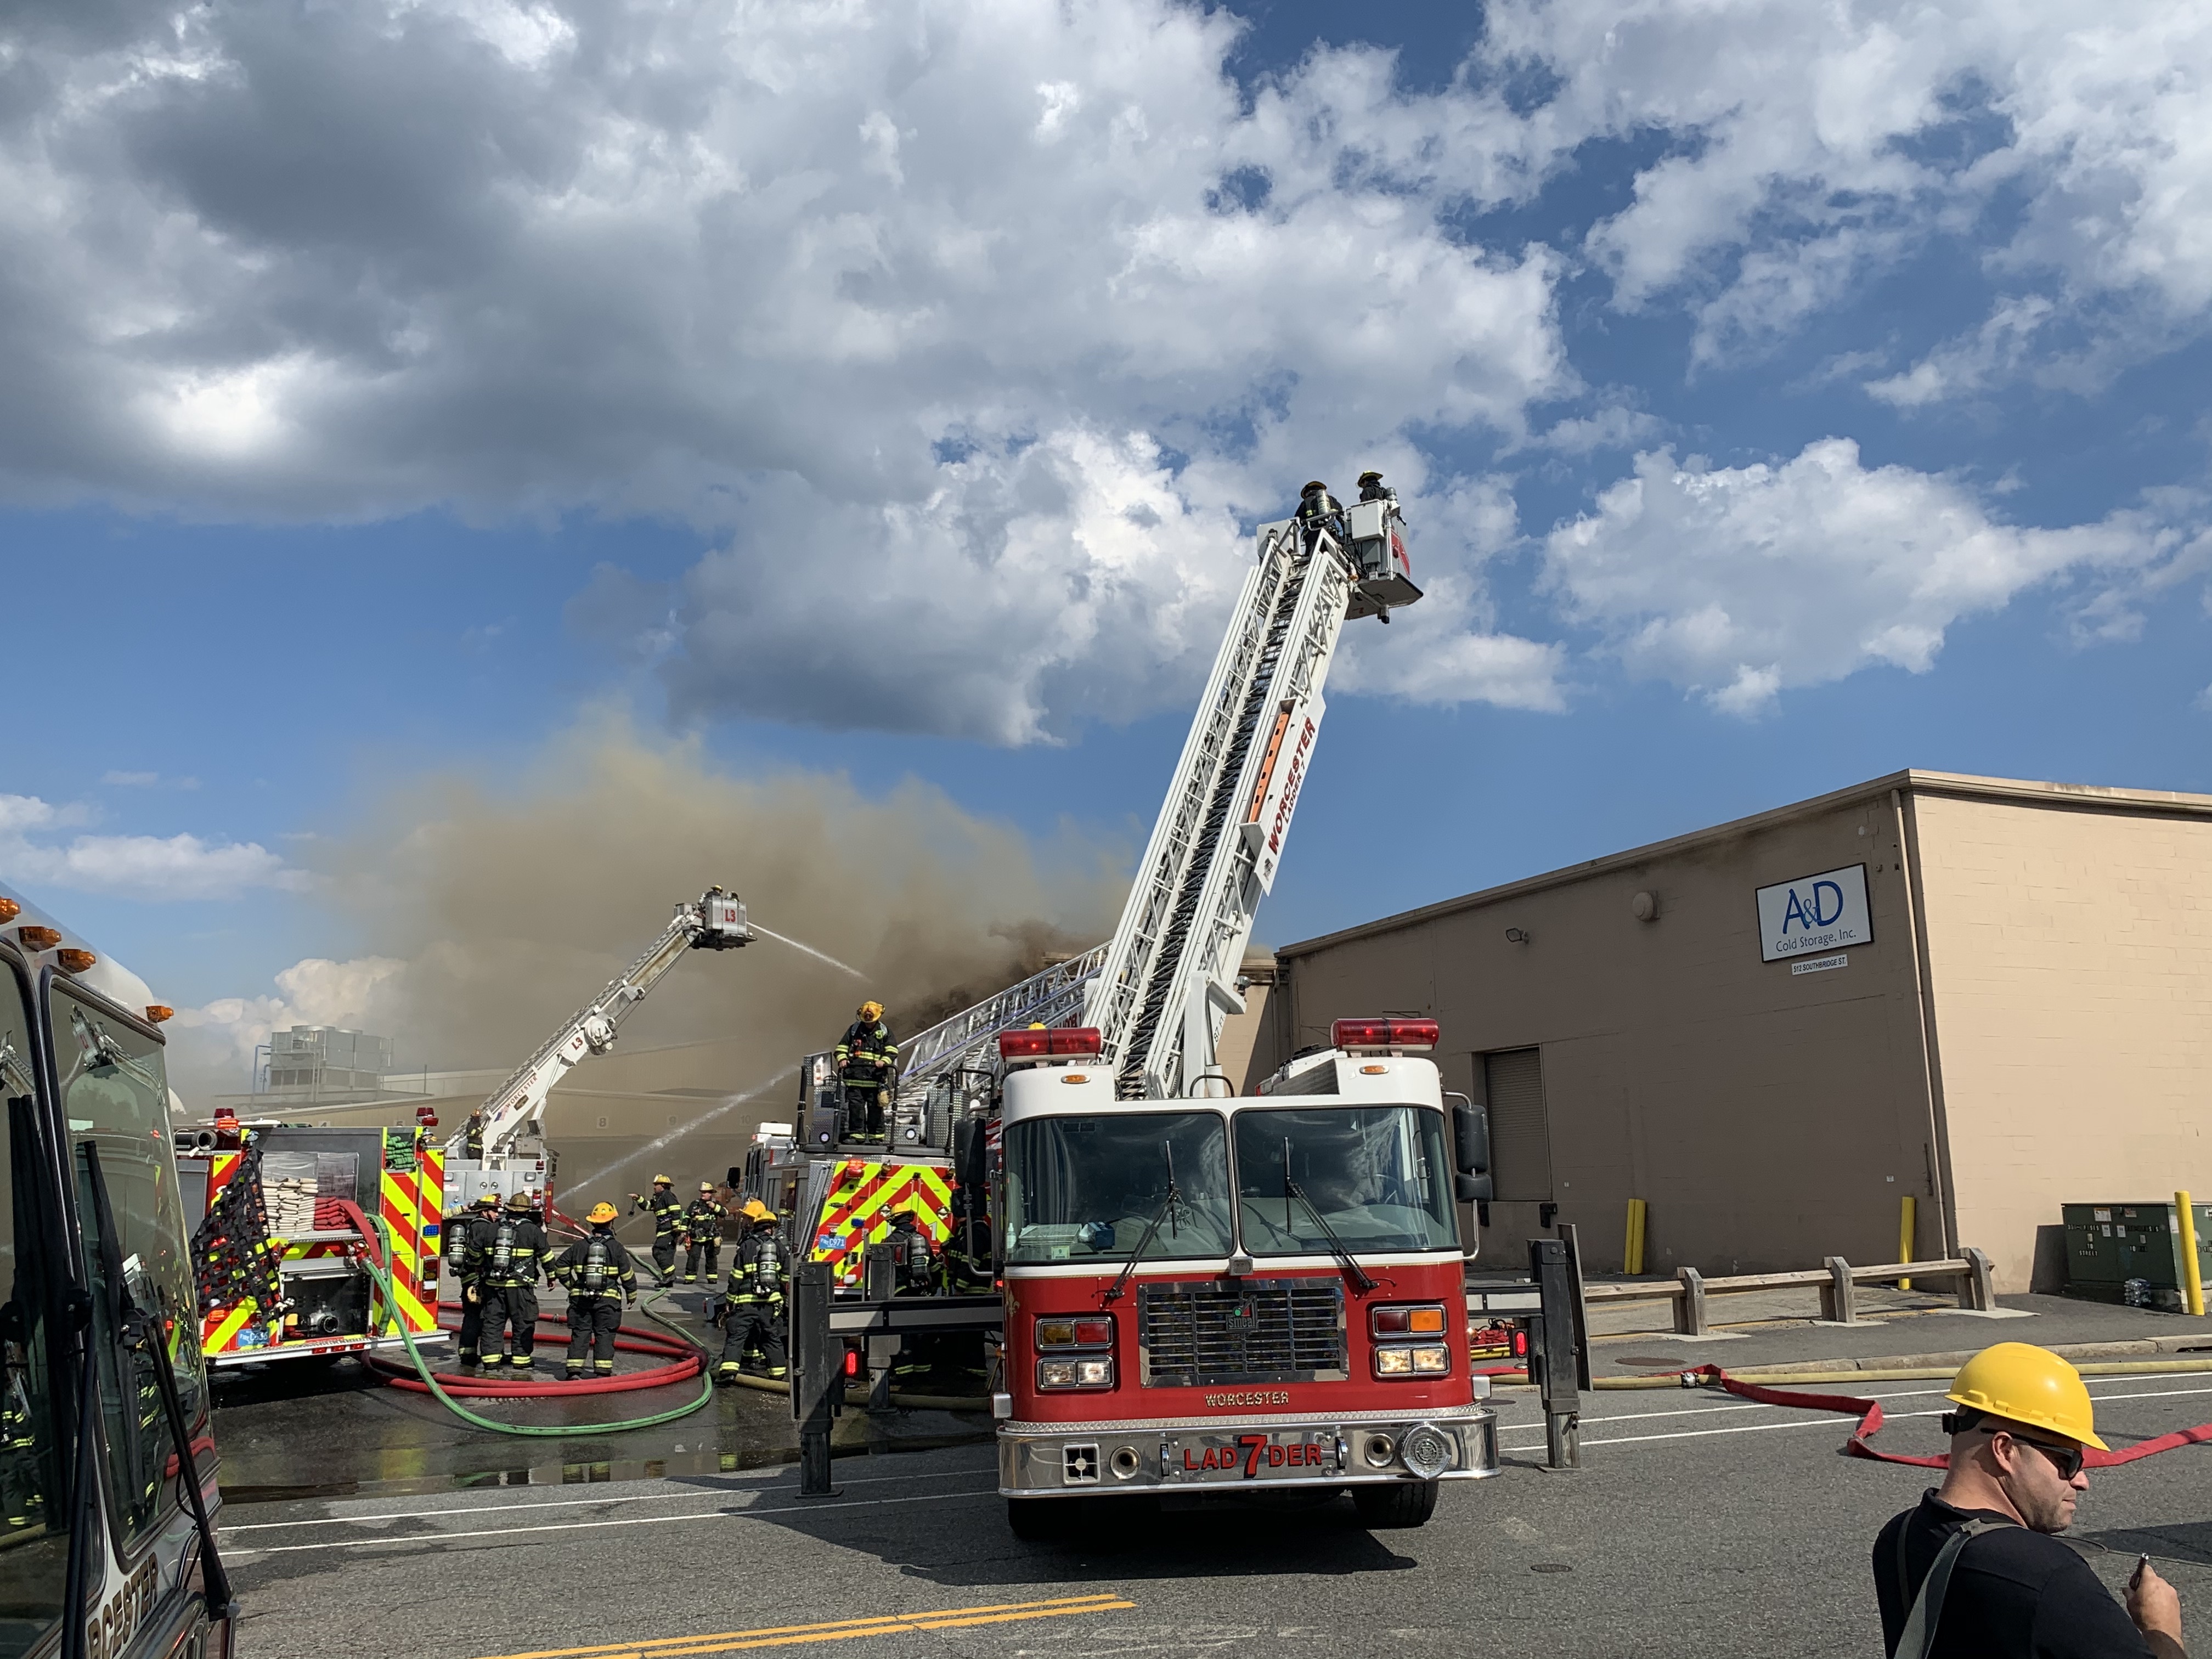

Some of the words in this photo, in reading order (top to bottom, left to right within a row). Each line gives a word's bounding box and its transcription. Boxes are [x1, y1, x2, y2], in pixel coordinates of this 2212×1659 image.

[1268, 716, 1316, 856] WORCESTER
[1285, 772, 1302, 824] LADDER
[1301, 760, 1305, 770] 7
[725, 909, 736, 922] L3
[1782, 881, 1843, 934] A&D
[1776, 939, 1797, 952] Cold
[1800, 933, 1837, 946] Storage,
[1839, 929, 1857, 940] Inc.
[1793, 964, 1802, 973] 512
[1802, 958, 1837, 971] SOUTHBRIDGE
[1214, 1026, 1220, 1042] 87
[571, 1036, 584, 1051] L3
[505, 1075, 538, 1109] WORCESTER
[599, 1118, 607, 1127] 8
[668, 1116, 676, 1126] 9
[741, 1115, 752, 1125] 10
[927, 1221, 937, 1241] 1
[829, 1238, 845, 1246] C971
[1204, 1391, 1289, 1408] WORCESTER
[1238, 1434, 1268, 1479] 7
